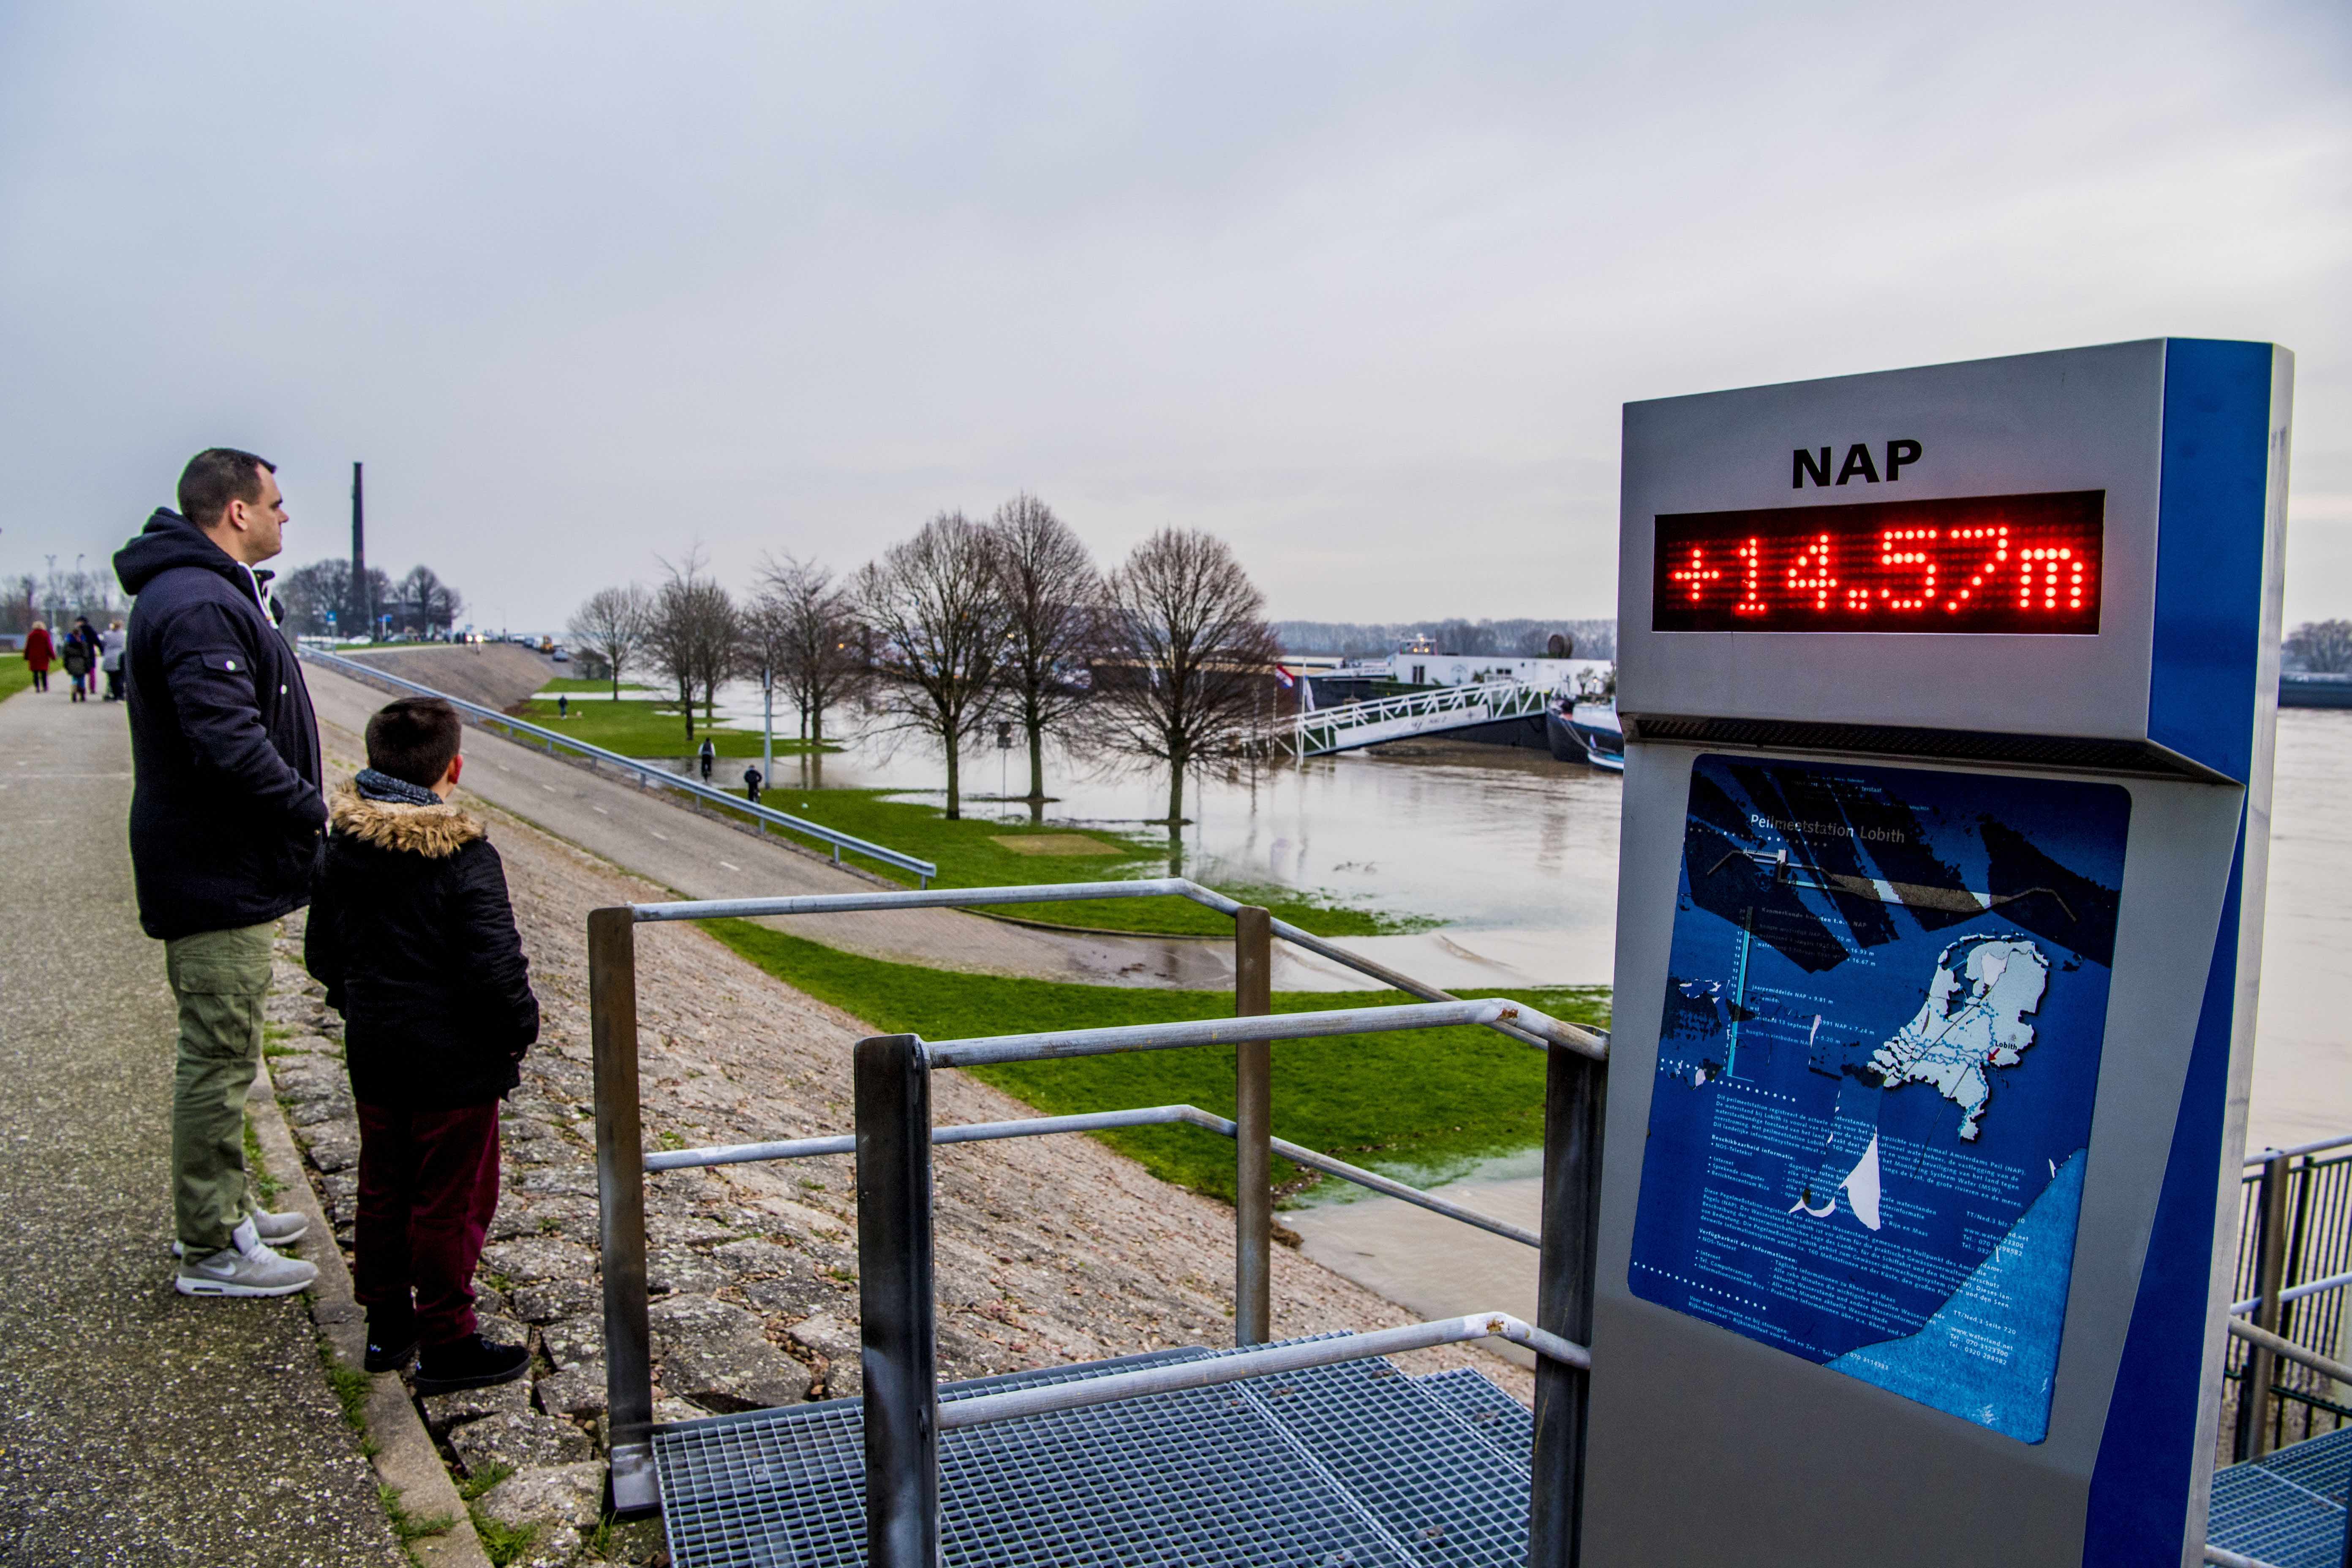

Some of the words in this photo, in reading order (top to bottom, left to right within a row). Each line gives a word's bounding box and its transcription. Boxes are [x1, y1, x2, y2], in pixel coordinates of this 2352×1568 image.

[1792, 439, 1922, 489] NAP
[1750, 813, 1855, 838] Peilmeetstation
[1859, 824, 1906, 844] Lobith
[1745, 1028, 1764, 1037] hoogte
[1820, 1035, 1834, 1043] 5.20
[1995, 1040, 2018, 1051] Lobith
[1715, 1107, 1763, 1124] waterstaatkundige
[1764, 1119, 1788, 1130] toestand
[1812, 1132, 1826, 1140] land,
[1724, 1102, 1753, 1114] waterstand
[1764, 1112, 1781, 1122] Lobith
[1789, 1119, 1807, 1128] vooral
[1726, 1096, 1768, 1111] peilmeetstation
[1769, 1106, 1798, 1119] registreert
[1808, 1116, 1828, 1126] actuele
[1711, 1133, 1759, 1152] Beschikbaarheid
[1713, 1114, 1750, 1129] overstroming.
[1762, 1127, 1805, 1143] peilmeetstation
[1807, 1138, 1824, 1147] Lobith
[1722, 1123, 1749, 1135] landelijke
[1750, 1131, 1800, 1149] informatiesysteem
[1801, 1144, 1818, 1153] omvat
[1713, 1156, 1734, 1166] Internet
[1715, 1142, 1752, 1157] NOS-Teletekst
[1881, 1134, 1907, 1146] opzichte
[1949, 1151, 1988, 1165] Amsterdams
[1990, 1161, 2003, 1169] Peil
[2004, 1165, 2026, 1176] (NAP).
[1711, 1170, 1757, 1187] Berichtencentrum
[1758, 1183, 1769, 1191] Riza
[1712, 1162, 1739, 1175] Sprekende
[1740, 1171, 1765, 1182] computer
[1786, 1176, 1806, 1187] actuele
[1922, 1160, 1957, 1175] beveiliging
[1984, 1176, 1999, 1185] land
[2000, 1181, 2020, 1192] tegen
[1930, 1170, 1955, 1182] Systeem
[1957, 1177, 1976, 1187] Water
[1978, 1183, 2003, 1194] (MSW).
[1957, 1161, 1995, 1177] vastlegging
[1881, 1165, 1898, 1175] langs
[1936, 1180, 1953, 1190] grote
[1954, 1185, 1979, 1196] rivieren
[2001, 1198, 2023, 1208] meren.
[1896, 1199, 1937, 1215] waterstanden
[1965, 1210, 1996, 1224] TT/Ned.3
[1702, 1200, 1737, 1216] Beschreibung
[1748, 1214, 1809, 1238] wasserwirtschaftlichen
[1810, 1233, 1824, 1243] Lage
[1837, 1241, 1859, 1253] Landes,
[1703, 1193, 1720, 1204] Pegels
[1721, 1199, 1738, 1209] (NAP).
[1750, 1208, 1785, 1223] Wasserstand
[1796, 1221, 1814, 1232] Lobith
[1835, 1233, 1852, 1243] allem
[1874, 1245, 1905, 1260] praktische
[1704, 1187, 1718, 1196] Diese
[1720, 1191, 1763, 1209] Pegelmeßstation
[1804, 1216, 1830, 1229] aktuellen
[1832, 1225, 1870, 1241] Wasserstand,
[1871, 1237, 1900, 1251] gemessen
[1913, 1249, 1944, 1263] Nullpunkt
[1712, 1211, 1741, 1225] Bedeutung.
[1753, 1223, 1798, 1242] Pegelmeßstation
[1799, 1237, 1817, 1248] Lobith
[1818, 1244, 1837, 1255] gehört
[1888, 1220, 1901, 1230] Rijn
[1912, 1227, 1928, 1237] Maas
[1699, 1227, 1738, 1246] Verfügbarkeit
[1752, 1244, 1797, 1264] Informationen:
[1700, 1214, 1723, 1226] desweite
[1724, 1222, 1776, 1243] Informationssystem
[1777, 1238, 1797, 1249] umfaßt
[1820, 1252, 1859, 1269] Meßstationen
[1880, 1271, 1900, 1282] Küste,
[1914, 1281, 1936, 1294] großen
[1700, 1250, 1720, 1260] Internet
[1702, 1236, 1736, 1252] NOS-Teletext
[1998, 1244, 2023, 1257] 298582
[1698, 1263, 1752, 1286] Informationszentrum
[1752, 1282, 1764, 1290] Riza
[1773, 1266, 1785, 1274] Alle
[1786, 1270, 1799, 1279] zehn
[1801, 1275, 1824, 1288] Minuten
[1836, 1287, 1870, 1303] wichtigsten
[1871, 1298, 1899, 1312] aktuellen
[1775, 1259, 1797, 1272] Tägliche
[1799, 1267, 1838, 1285] Informationen
[1848, 1282, 1865, 1293] Rhein
[1880, 1293, 1896, 1303] Maas
[1772, 1273, 1795, 1285] Aktuelle
[1797, 1281, 1835, 1299] Wasserstände
[1849, 1299, 1869, 1310] andere
[1975, 1285, 1998, 1296] Dieses
[1993, 1298, 2011, 1309] Seen.
[1689, 1295, 1701, 1304] Voor
[1702, 1300, 1715, 1308] meer
[1716, 1304, 1743, 1318] informatie
[1761, 1320, 1788, 1335] storingen:
[1770, 1287, 1798, 1301] Praktische
[1799, 1298, 1839, 1315] Informationen
[1840, 1311, 1854, 1320] über
[1868, 1320, 1886, 1331] Rhein
[1799, 1290, 1822, 1302] Minuten
[1823, 1298, 1846, 1310] aktuelle
[1848, 1306, 1888, 1324] Wasserstände
[1952, 1309, 1983, 1324] TT/Ned.3
[1985, 1320, 2001, 1331] Seite
[1688, 1301, 1727, 1320] Rijkswaterstaat
[1783, 1335, 1796, 1344] Kust
[1950, 1325, 2013, 1351] www.waterland.net
[1862, 1356, 1889, 1371] 3114333
[1964, 1345, 1981, 1357] 0320
[1982, 1352, 2007, 1366] 298582
